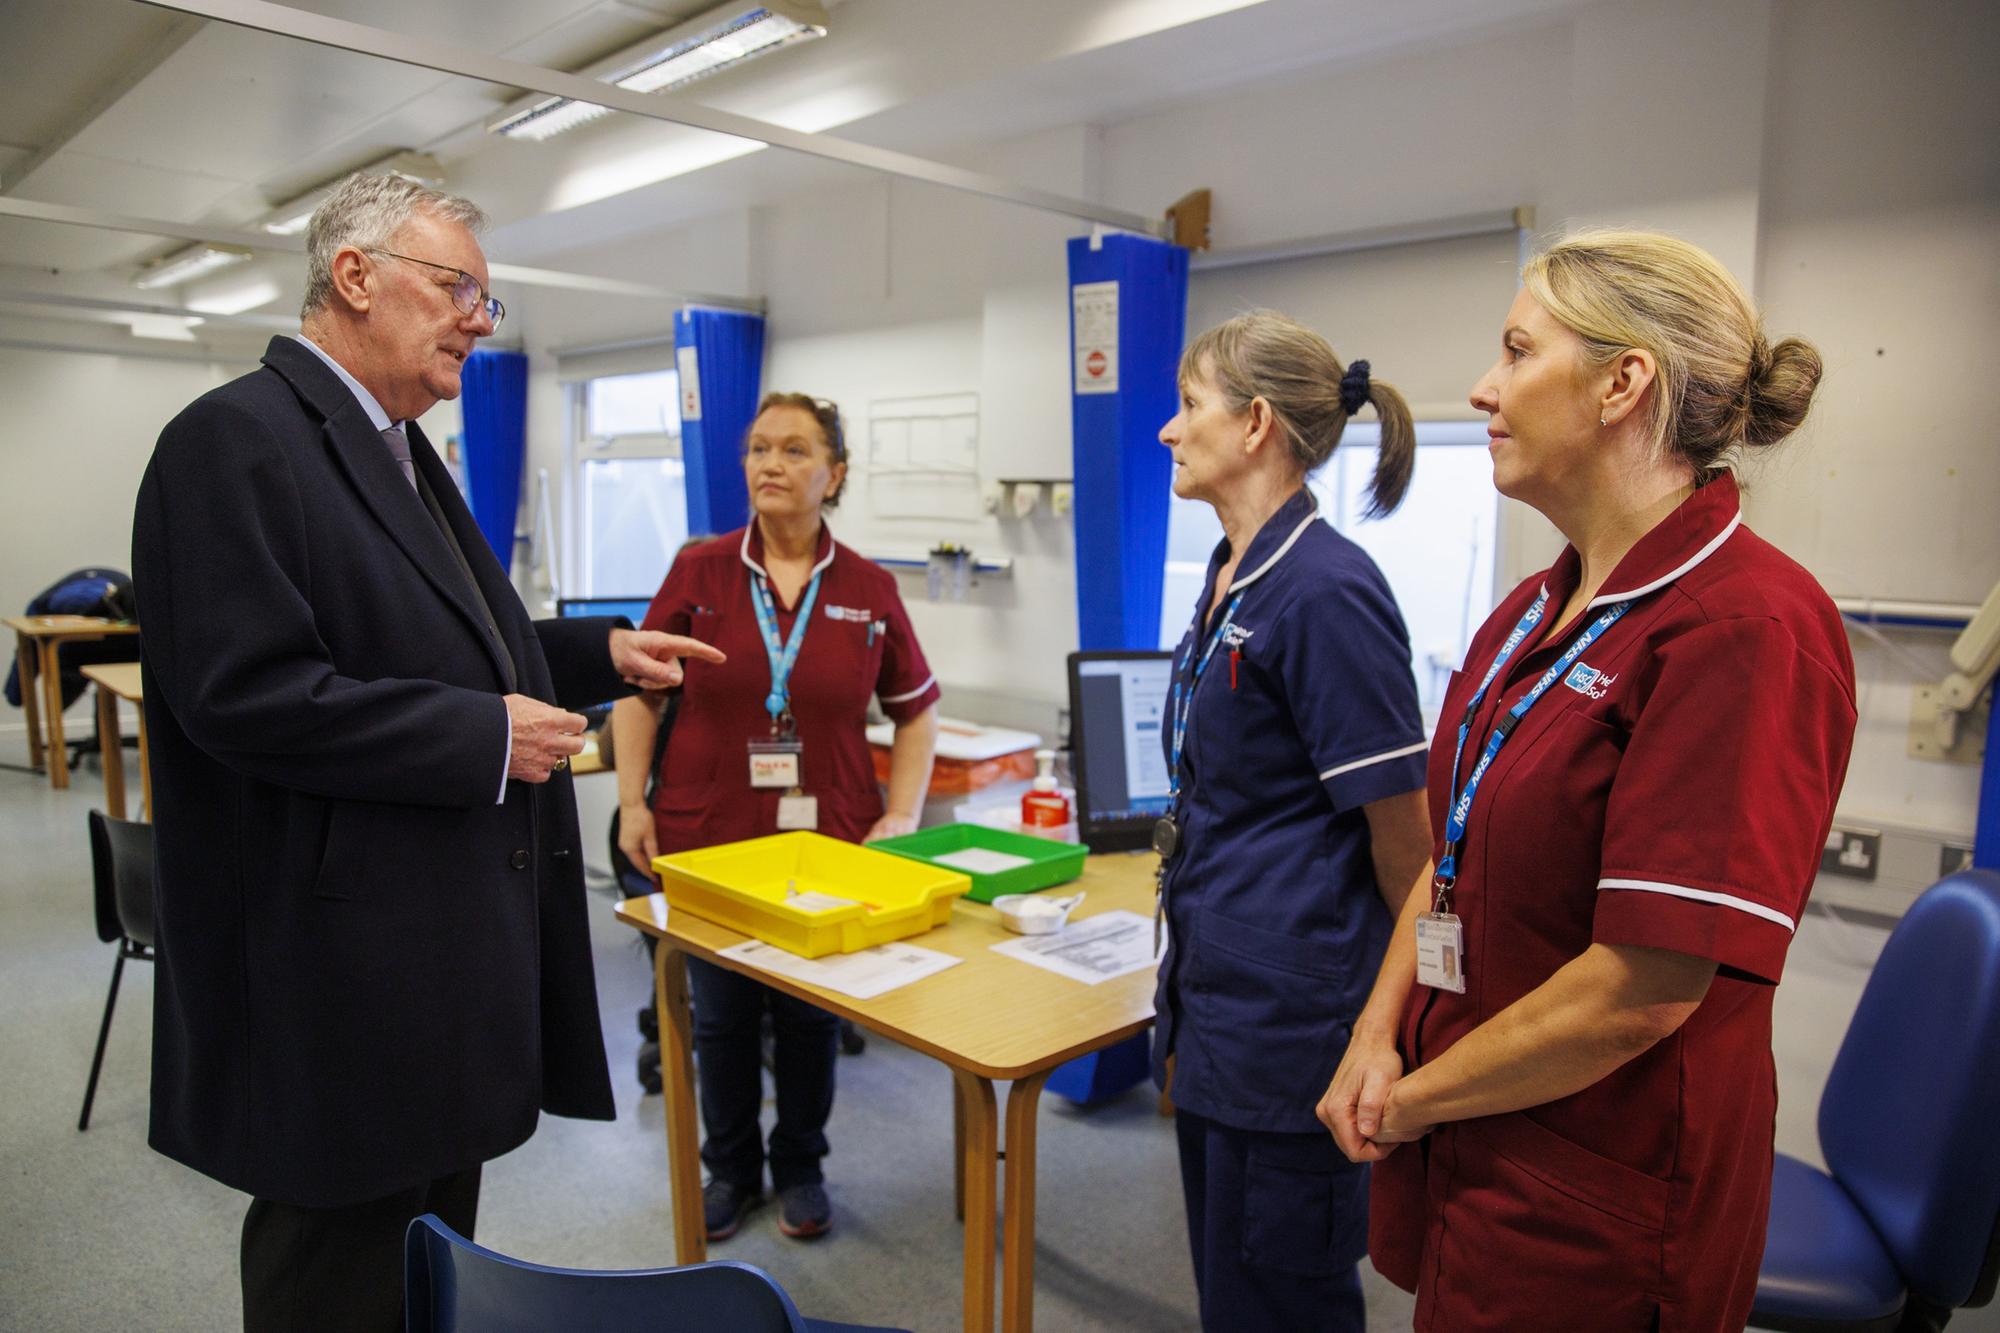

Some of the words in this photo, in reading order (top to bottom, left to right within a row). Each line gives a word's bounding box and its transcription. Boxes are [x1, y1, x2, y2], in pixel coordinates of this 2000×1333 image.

[1600, 601, 1629, 628] NHS
[1502, 628, 1525, 655] NHS
[1564, 632, 1593, 662] NHS
[1531, 667, 1558, 698] NHS
[1472, 752, 1490, 787] NHS
[1453, 792, 1471, 827] NHS
